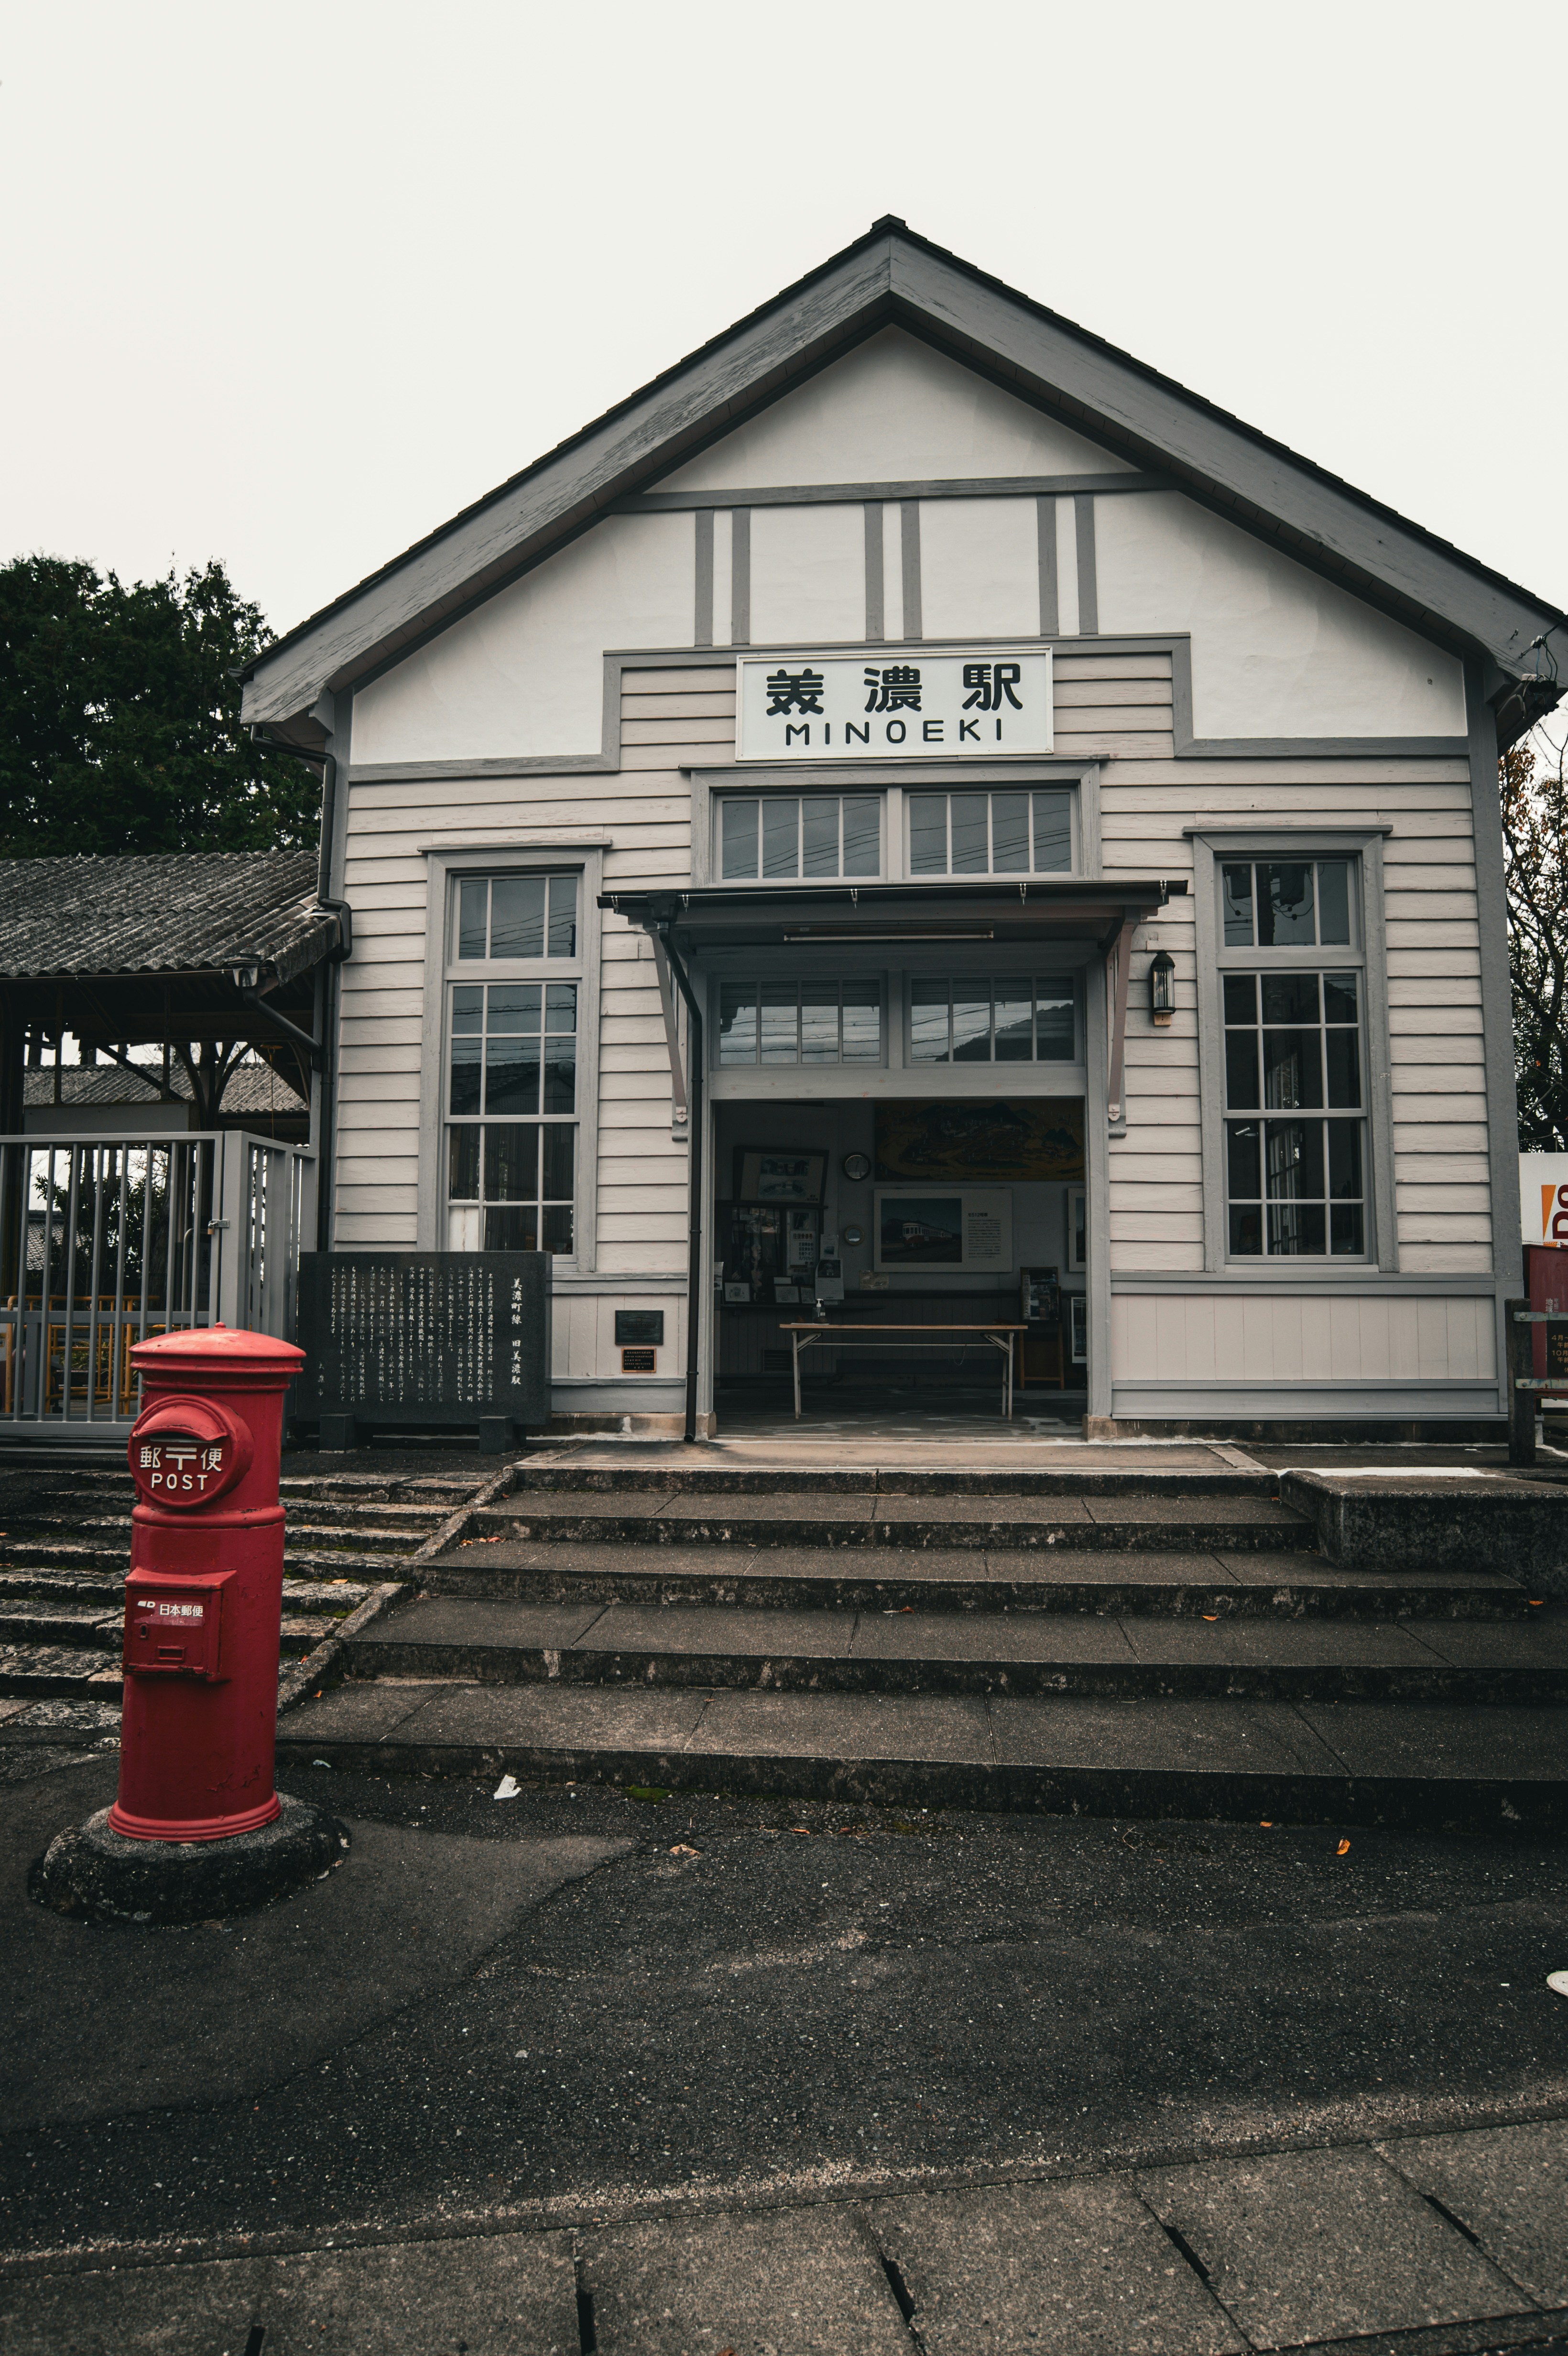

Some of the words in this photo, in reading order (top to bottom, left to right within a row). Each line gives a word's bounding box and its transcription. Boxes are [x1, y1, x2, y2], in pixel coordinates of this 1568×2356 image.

[766, 663, 1023, 716] 美濃駅
[785, 718, 1002, 746] MINOEKI
[511, 1277, 523, 1325] 美濃町線
[511, 1339, 522, 1385] 旧美濃駅
[152, 1473, 208, 1491] POST
[160, 1604, 203, 1617] 日本郵便
